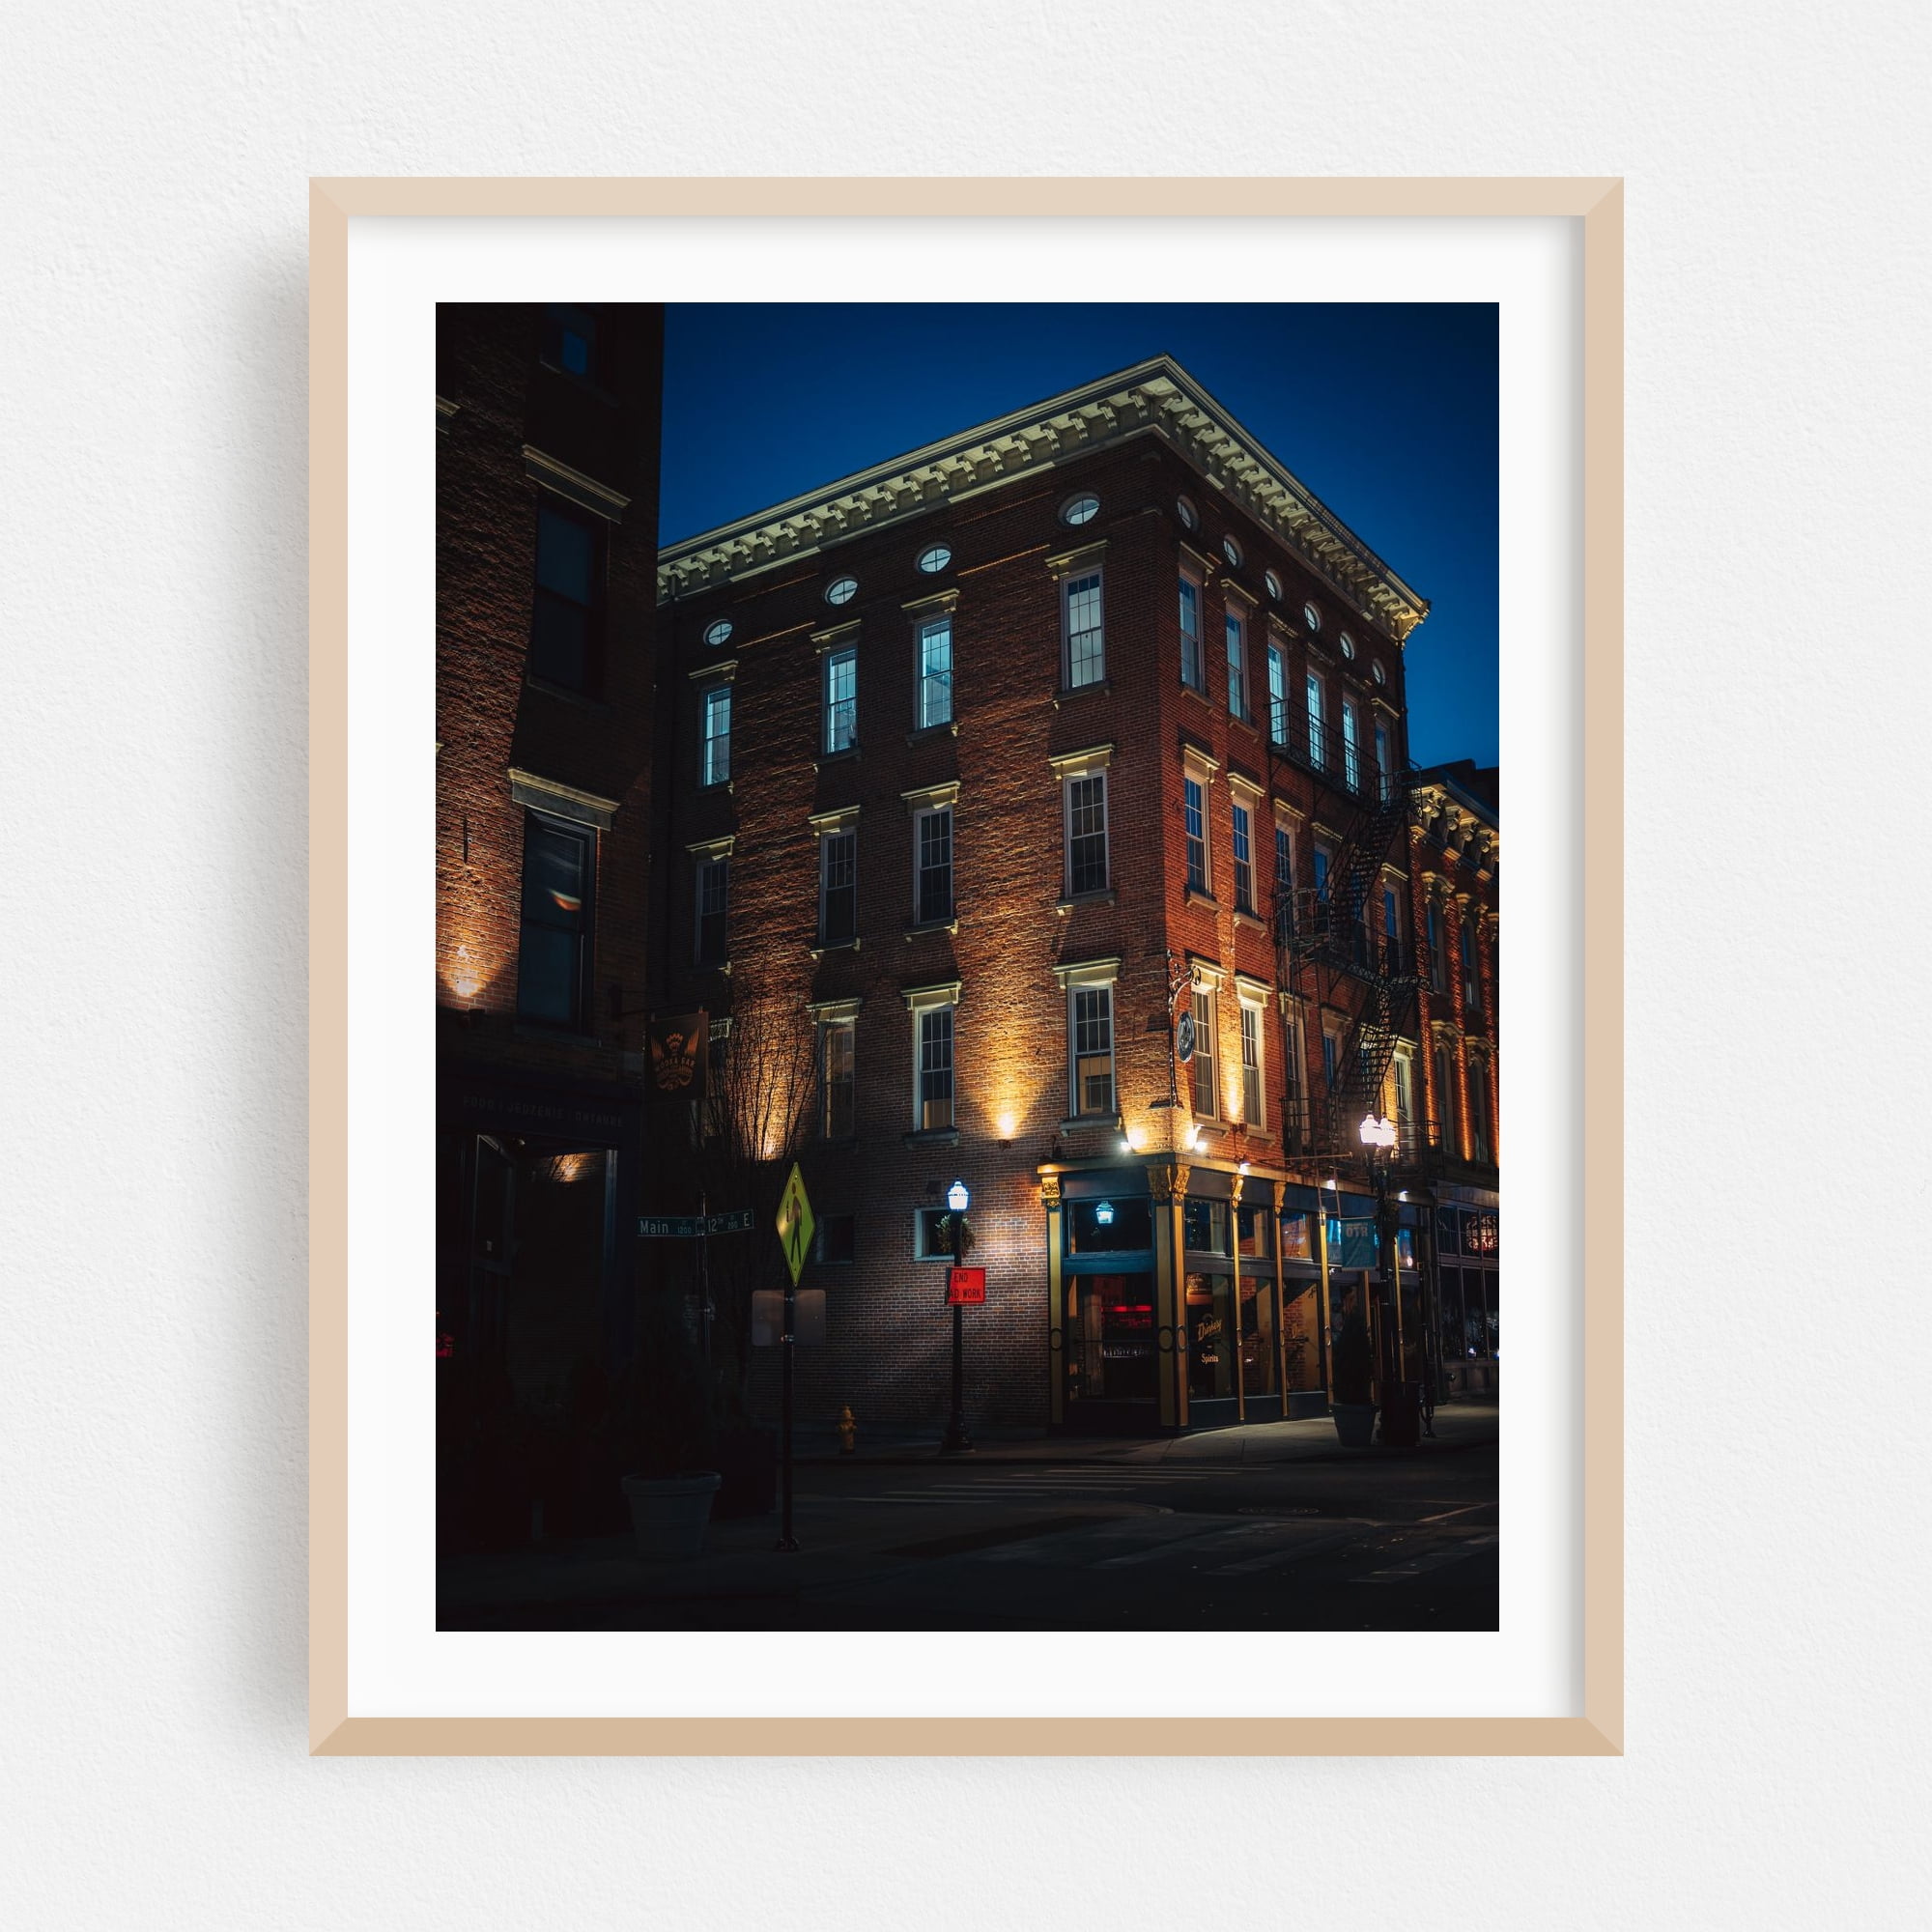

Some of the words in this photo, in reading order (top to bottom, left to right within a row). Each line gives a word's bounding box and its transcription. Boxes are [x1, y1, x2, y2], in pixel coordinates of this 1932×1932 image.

[743, 1213, 750, 1227] E
[639, 1220, 668, 1235] Main
[953, 1271, 969, 1283] END
[962, 1288, 981, 1299] WORK
[1201, 1352, 1219, 1365] Spirits
